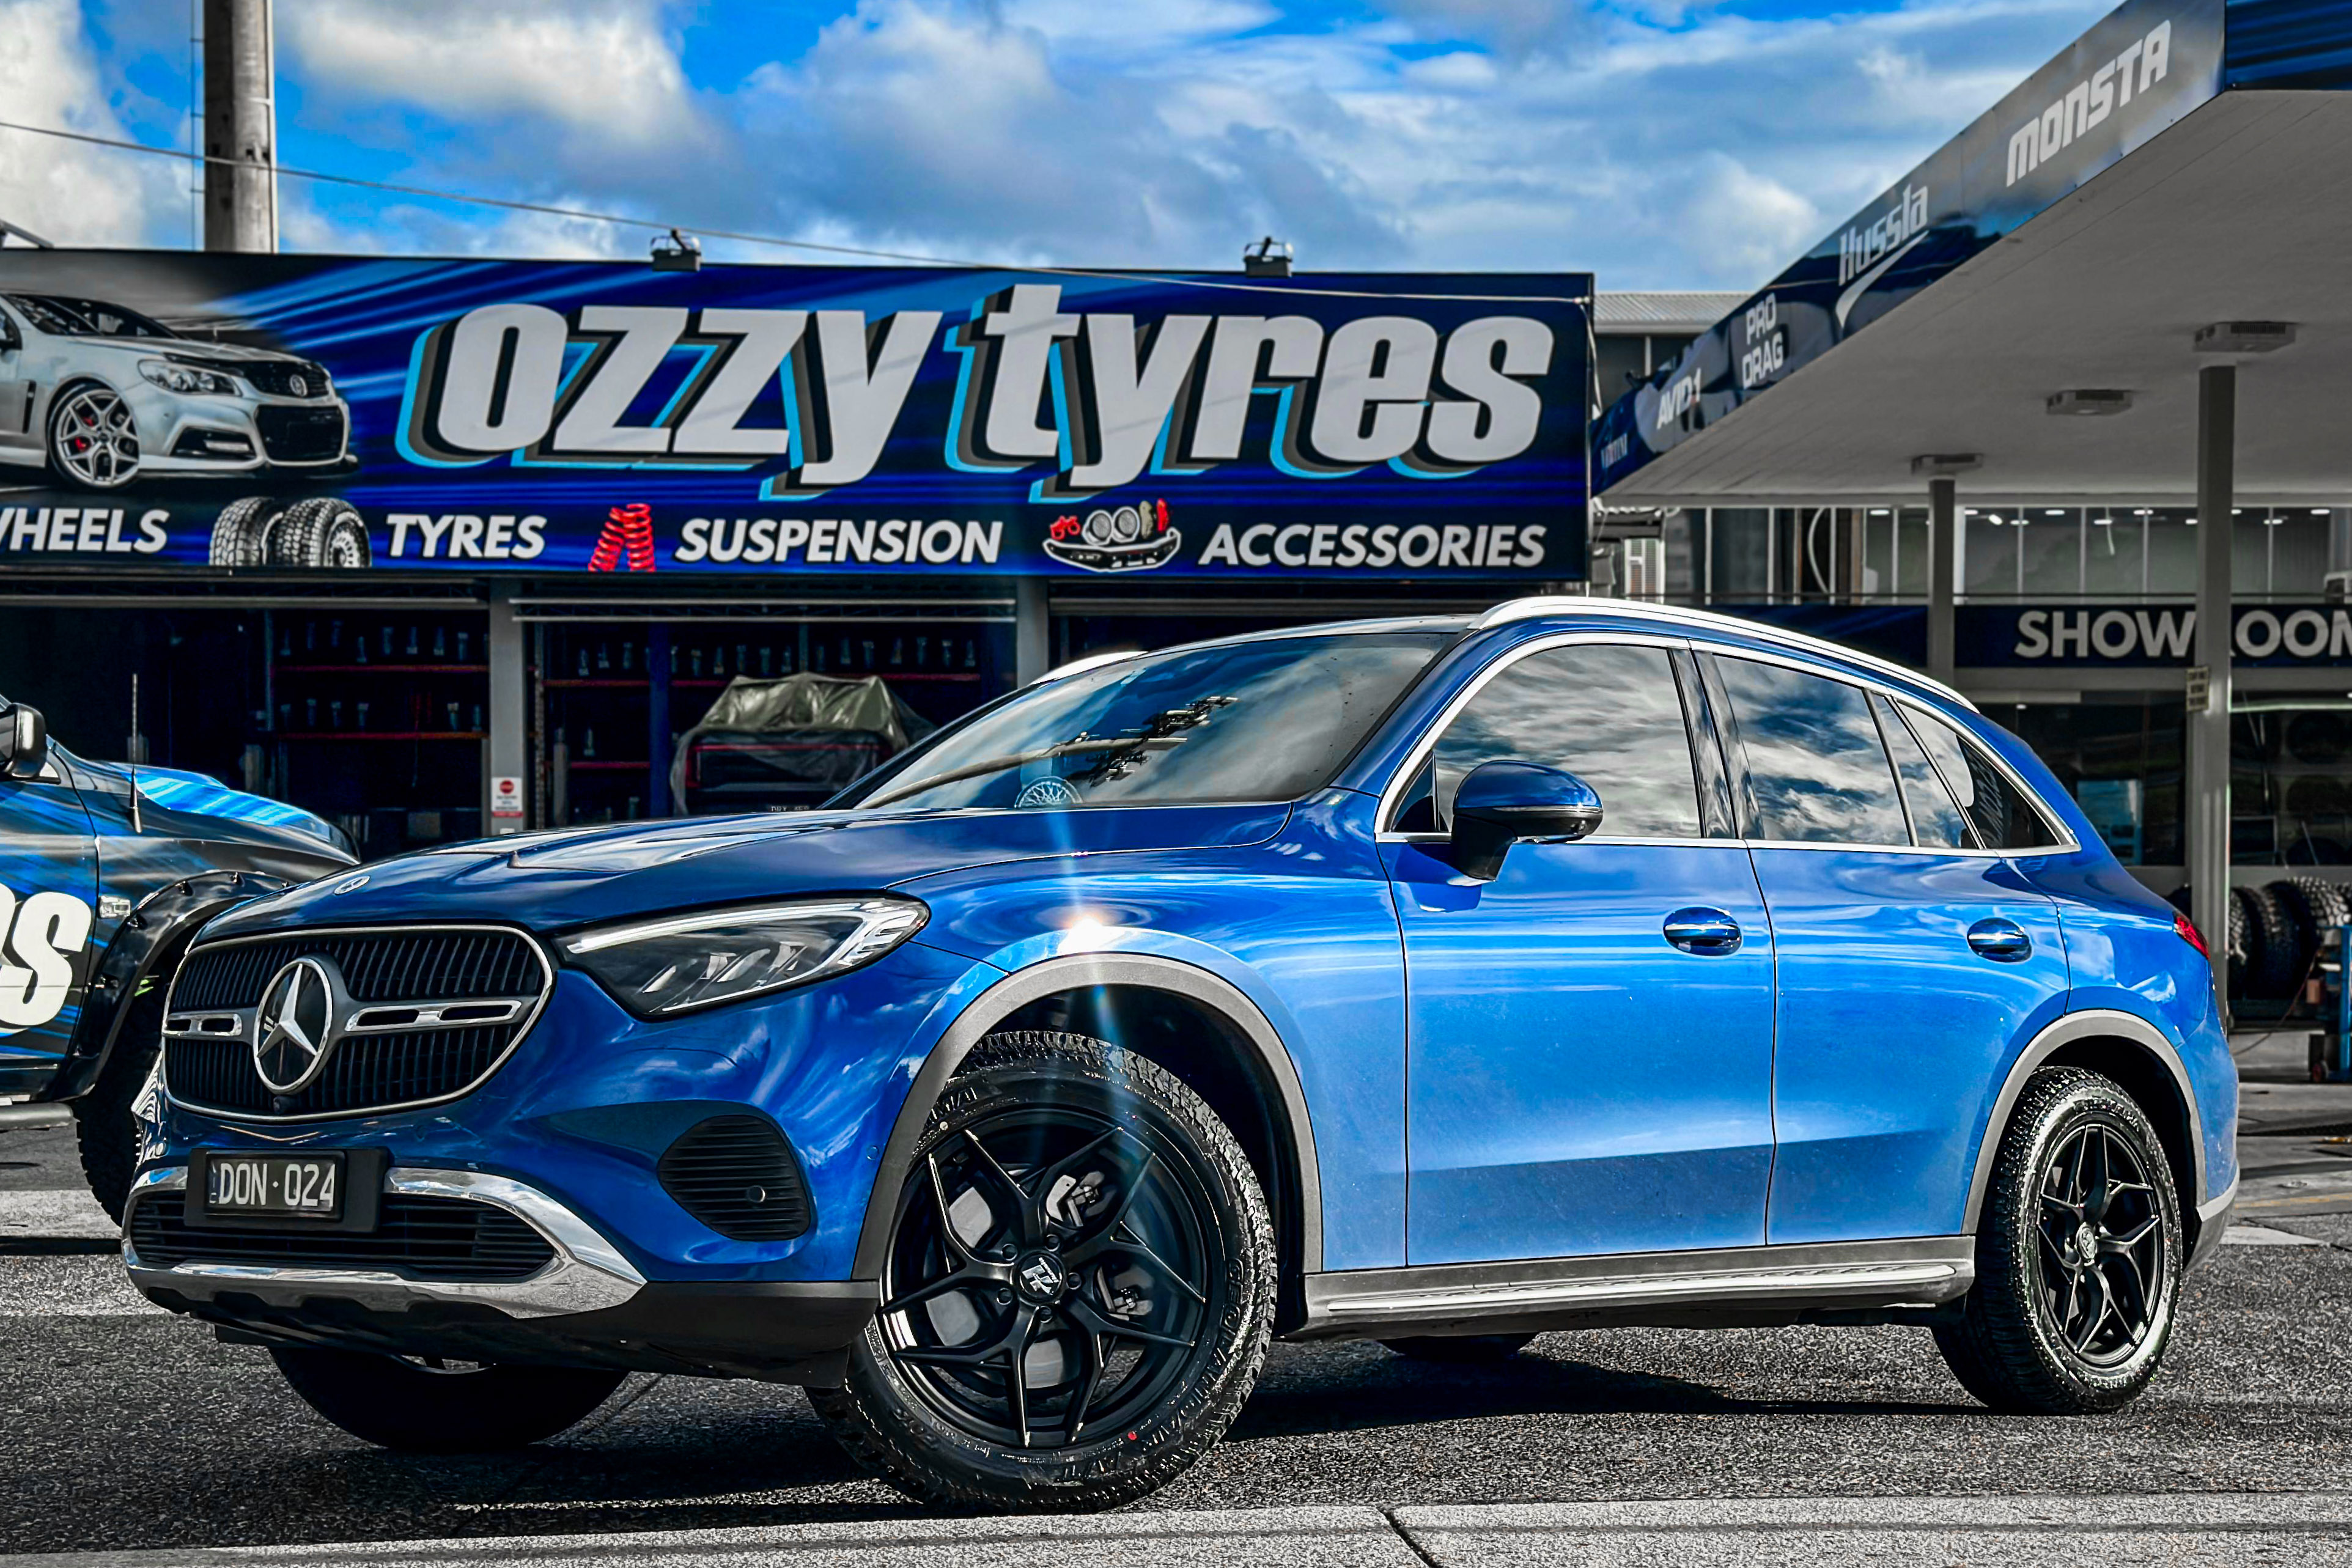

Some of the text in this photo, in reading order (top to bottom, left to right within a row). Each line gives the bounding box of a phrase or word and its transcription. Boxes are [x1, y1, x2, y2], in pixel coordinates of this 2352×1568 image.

[2006, 20, 2172, 187] MONSTA
[1746, 293, 1777, 344] PRO
[438, 284, 1554, 488] ozzy tyres
[1742, 332, 1783, 389] DRAG
[387, 514, 547, 559] TYRES
[675, 518, 1003, 564] SUSPENSION
[1198, 523, 1547, 569] ACCESSORIES
[2015, 610, 2352, 658] SHOWOO
[219, 1163, 336, 1207] DON 024
